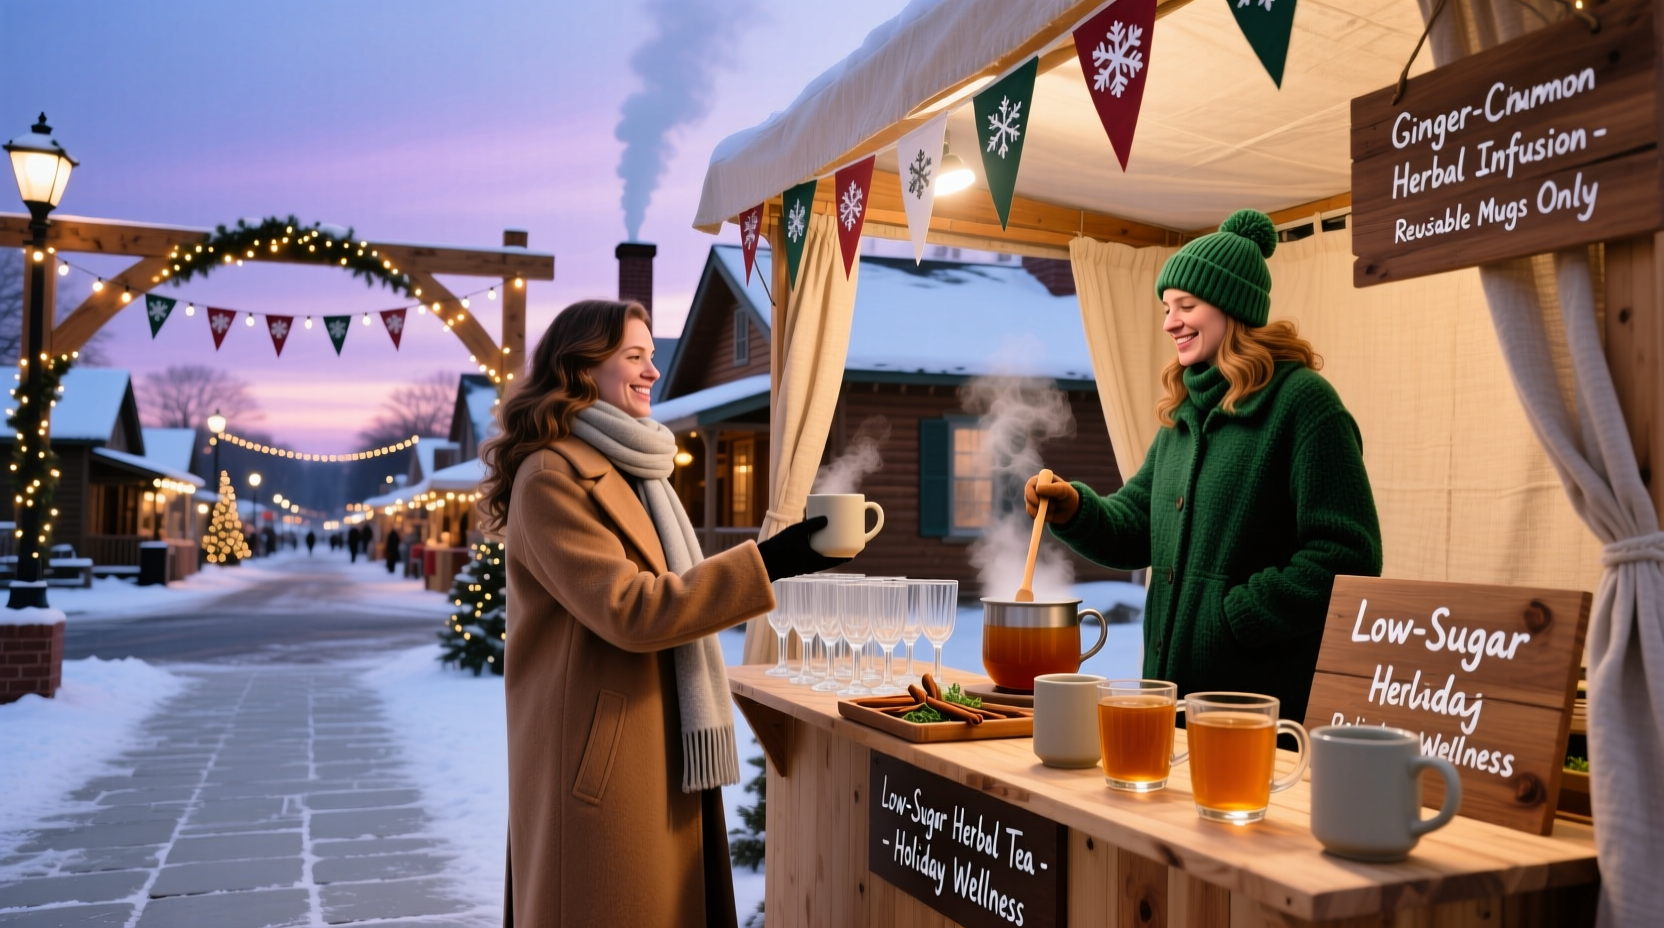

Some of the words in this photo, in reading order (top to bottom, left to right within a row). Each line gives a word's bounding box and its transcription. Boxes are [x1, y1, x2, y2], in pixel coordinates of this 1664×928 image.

[1392, 146, 1465, 199] Herbal
[1475, 128, 1587, 178] Infusion
[1394, 203, 1471, 244] Reusable
[1477, 197, 1528, 231] Mugs
[1536, 172, 1599, 222] Only
[1351, 598, 1531, 672] Low-Sugar
[1419, 731, 1515, 778] Wellness
[881, 774, 948, 840] Low-Sugar
[952, 805, 999, 859] Herbal
[1006, 827, 1035, 876] Tea
[894, 828, 946, 897] Holiday
[953, 856, 1025, 927] Wellness
